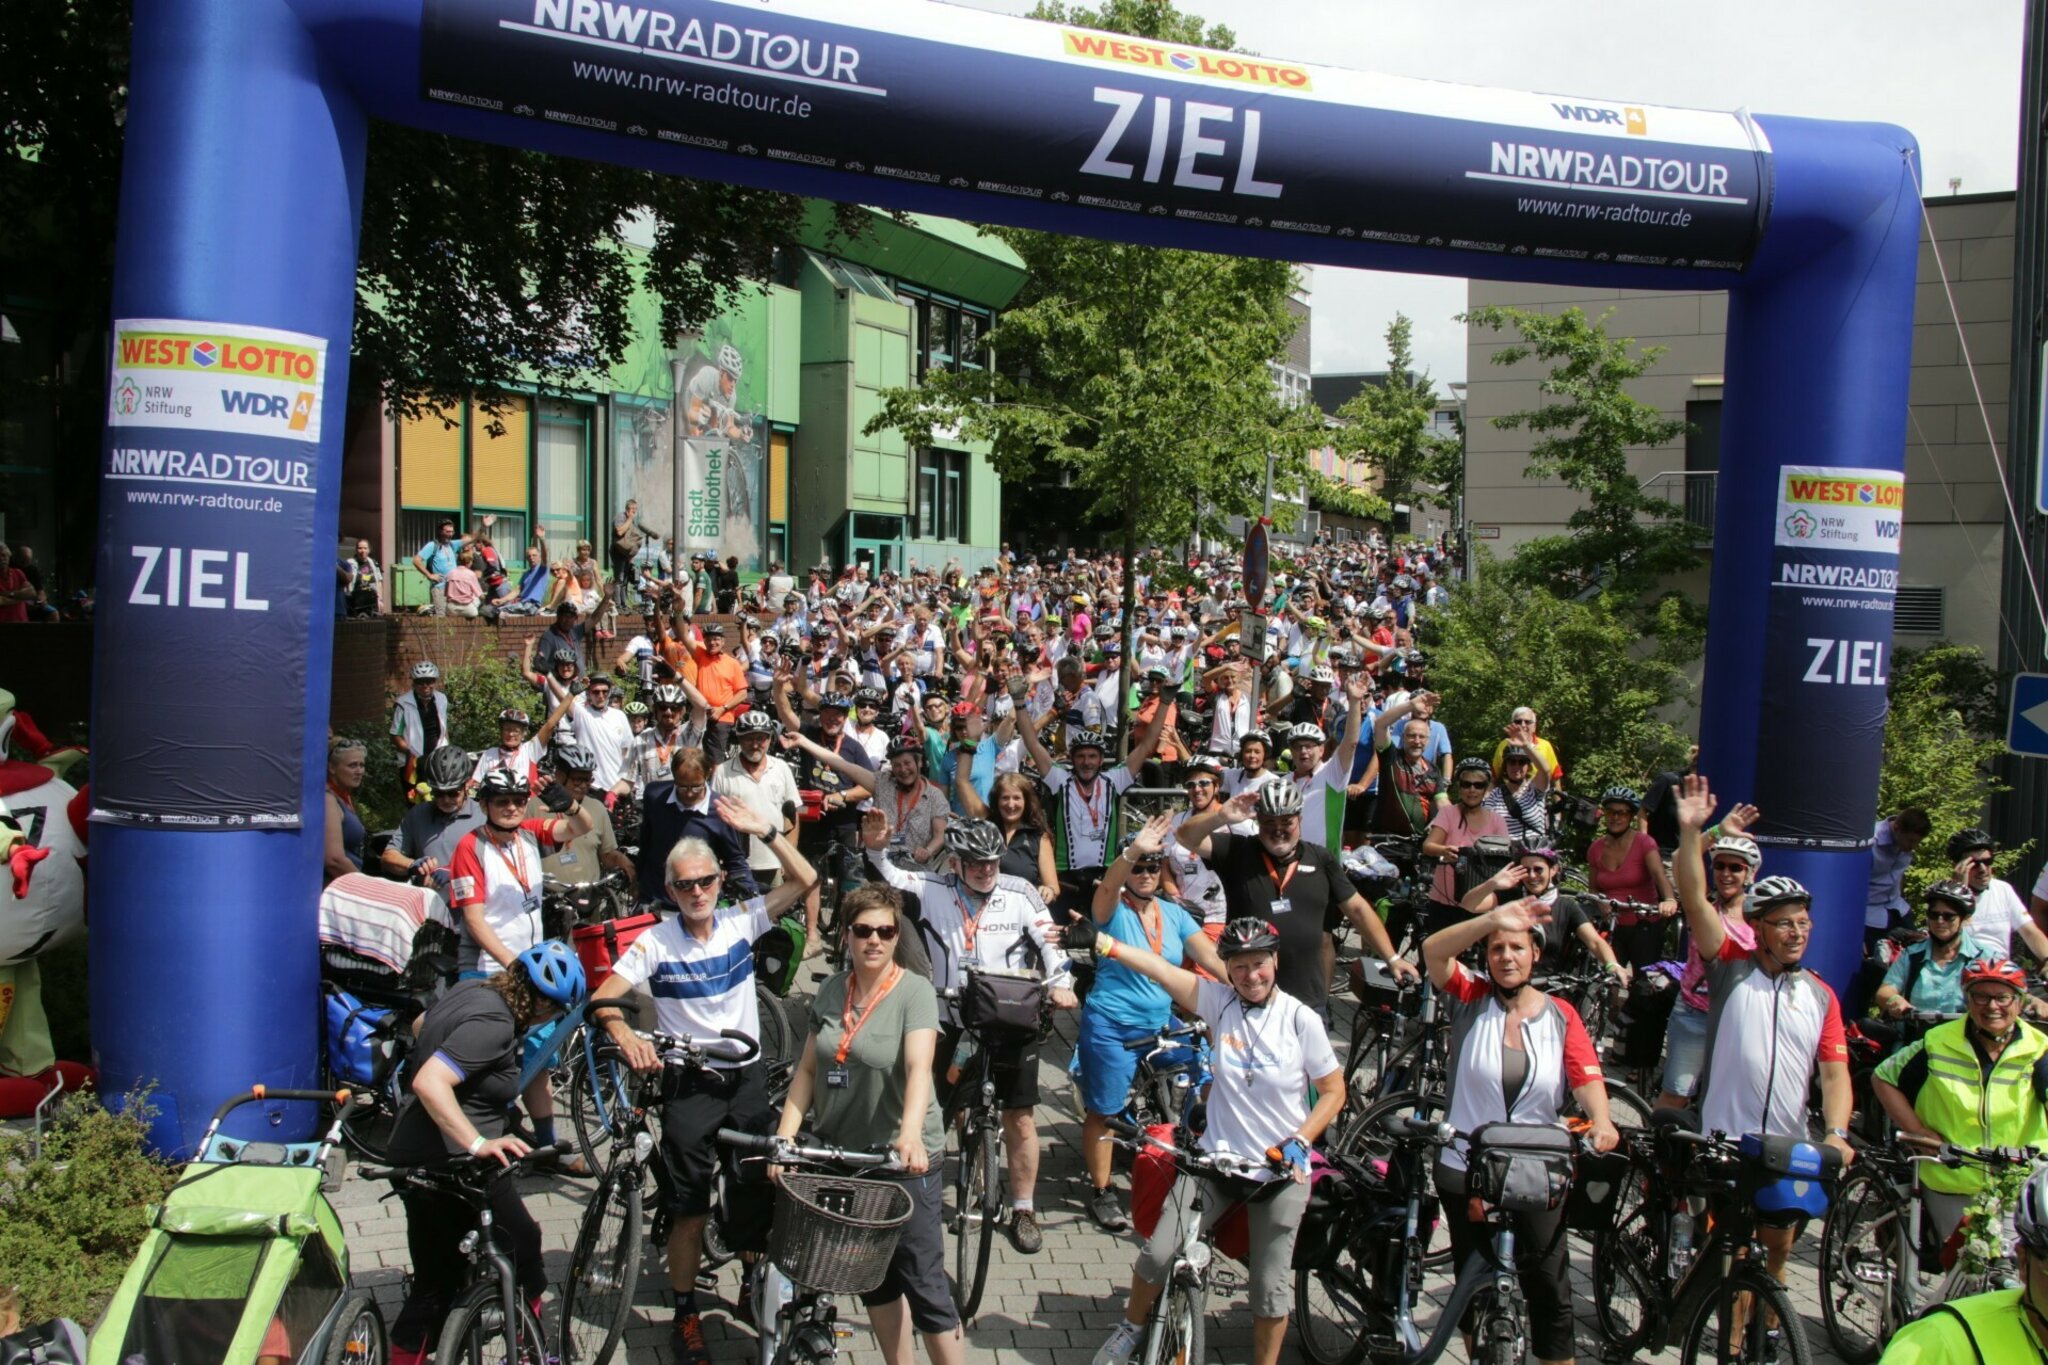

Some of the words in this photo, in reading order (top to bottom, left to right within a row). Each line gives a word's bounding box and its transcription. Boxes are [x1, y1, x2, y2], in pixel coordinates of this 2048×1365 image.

[534, 0, 860, 83] NRWRADTOUR
[1068, 33, 1165, 67] WEST
[1199, 56, 1309, 88] LOTTO
[429, 88, 503, 110] NRWRADTOUR
[573, 58, 812, 119] www.nrw-radtour.de
[545, 109, 617, 131] NRWRADTOUR
[1550, 103, 1625, 126] WDR
[658, 129, 728, 150] NRWRADTOUR
[1079, 86, 1284, 199] ZIEL
[767, 148, 837, 167] NRWRADTOUR
[1491, 142, 1729, 196] NRWRADTOUR
[874, 165, 941, 183] NRWRADTOUR
[977, 181, 1044, 198] NRWRADTOUR
[1078, 194, 1141, 212] NRWRADTOUR
[1517, 197, 1692, 228] www.nrw-radtour.de
[1175, 208, 1238, 224] NRWRADTOUR
[121, 338, 191, 365] WEST
[221, 344, 315, 380] LOTTO
[145, 386, 173, 399] NRW
[145, 401, 192, 418] Stiftung
[221, 389, 289, 420] WDR
[111, 449, 309, 487] NRWRADTOUR
[127, 491, 283, 513] www.nrw-radtour.de
[704, 448, 722, 537] Bibliothek
[1791, 480, 1857, 503] WEST
[688, 489, 703, 537] Stadt
[1821, 518, 1845, 528] NRW
[1820, 528, 1858, 543] Stiftung
[128, 545, 269, 611] ZIEL
[1802, 638, 1886, 686] ZIEL
